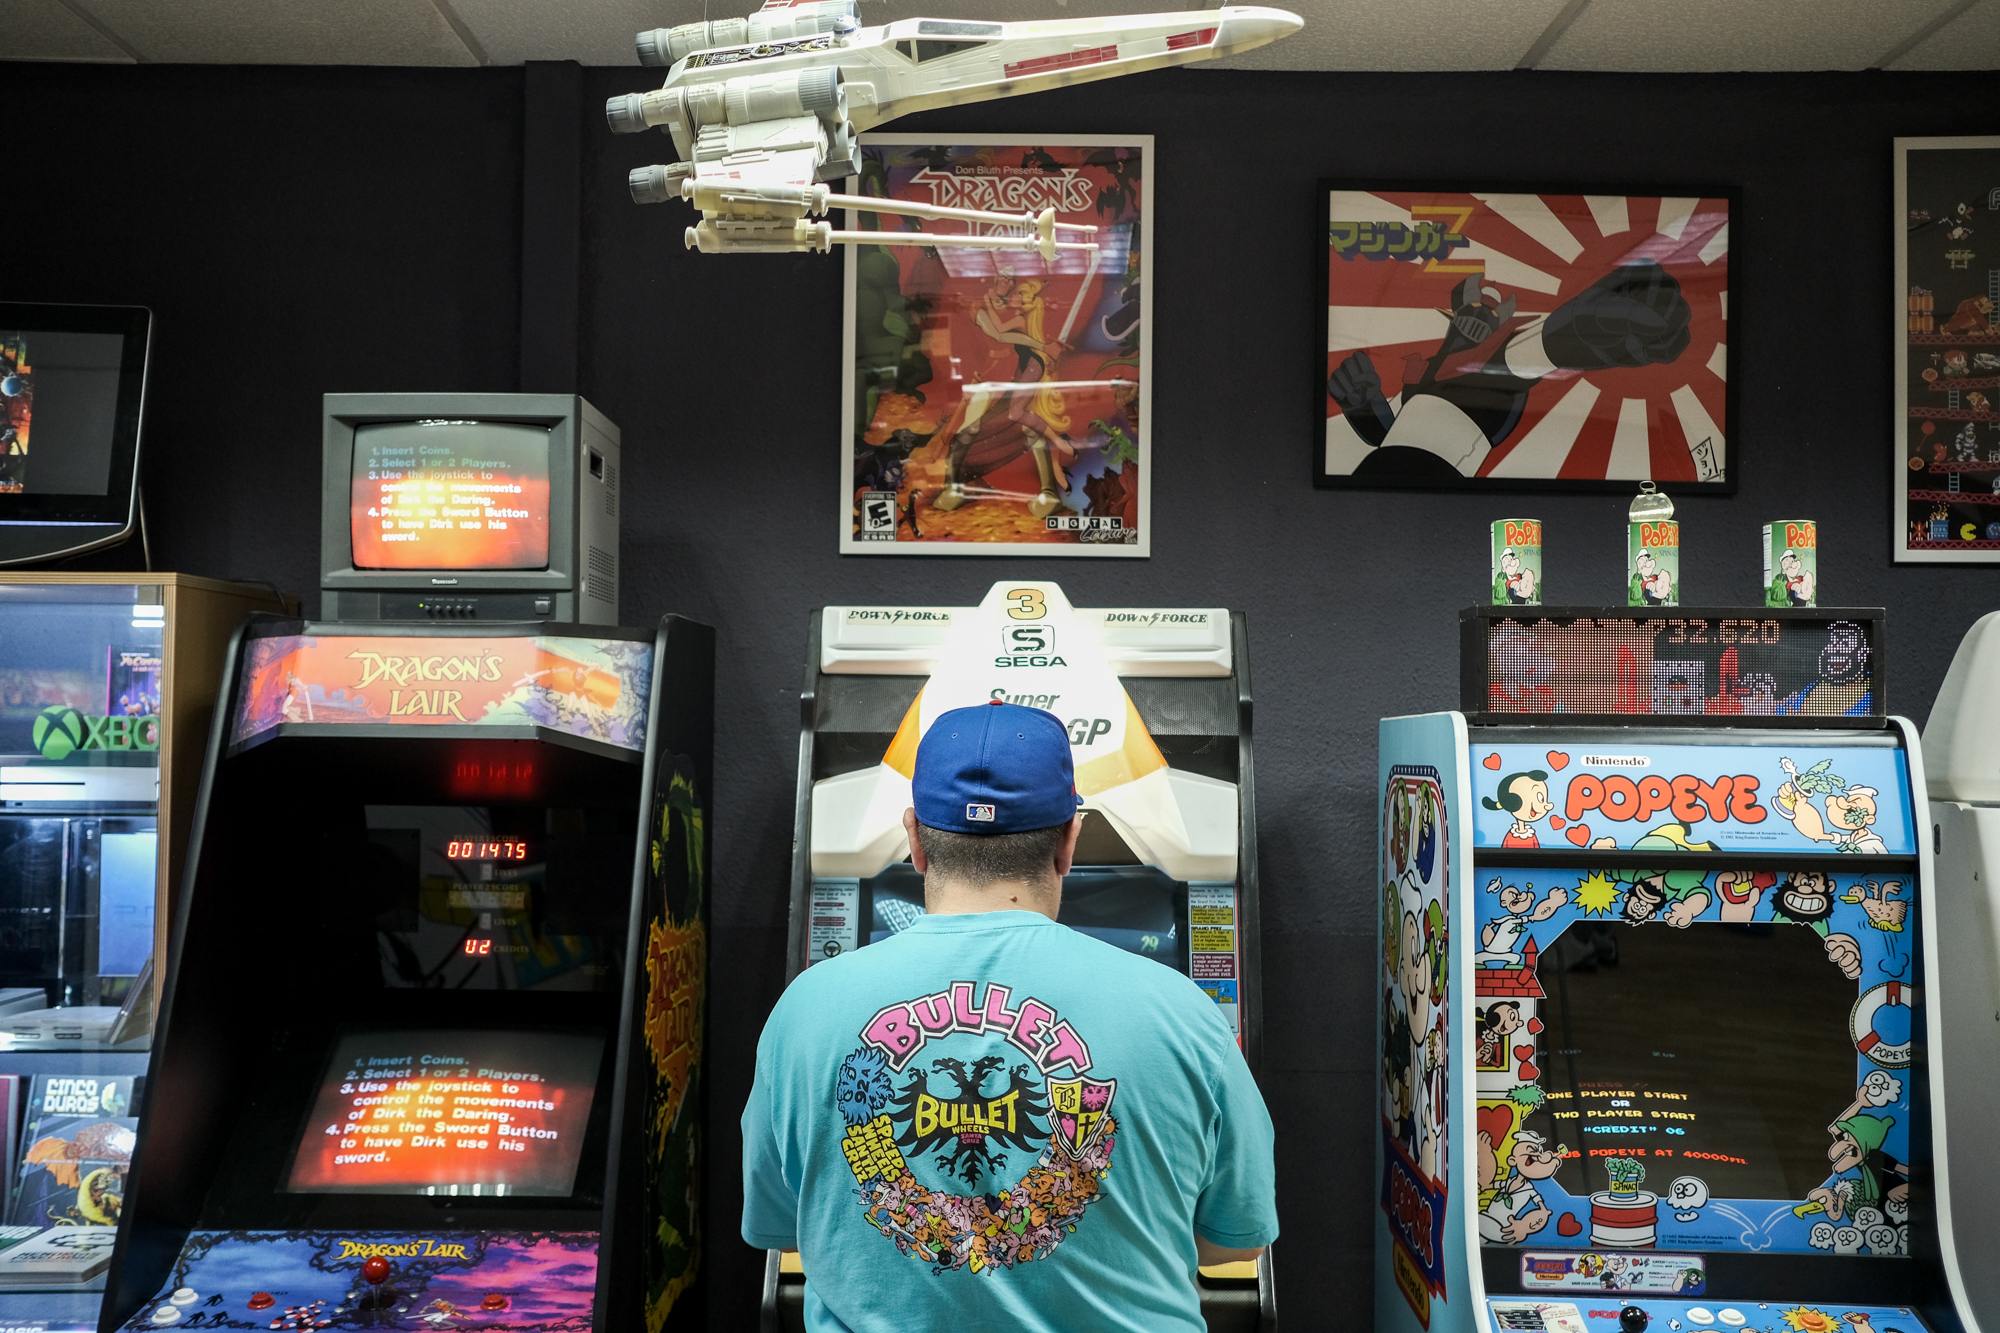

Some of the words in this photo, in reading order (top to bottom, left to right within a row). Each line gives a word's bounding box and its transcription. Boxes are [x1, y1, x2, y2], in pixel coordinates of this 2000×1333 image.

[955, 166, 974, 175] Don
[976, 166, 1000, 175] Bluth
[1003, 166, 1043, 175] Presents
[382, 447, 414, 455] Insert
[382, 458, 415, 468] Select
[448, 459, 456, 467] 2
[462, 458, 511, 469] Players.
[369, 471, 379, 480] 3.
[381, 471, 402, 480] Use
[407, 471, 425, 480] the
[430, 471, 474, 482] joystick
[481, 472, 493, 480] to
[381, 496, 393, 505] of
[368, 508, 379, 517] 4.
[485, 508, 529, 519] Button
[381, 520, 394, 529] to
[460, 521, 482, 530] use
[488, 520, 508, 530] his
[1047, 517, 1121, 529] DIGITAL
[1006, 588, 1047, 620] 3
[1105, 612, 1150, 623] DOWN
[1160, 613, 1208, 624] FORCE
[347, 649, 503, 689] DRAGON'S
[994, 656, 1067, 668] SEGA
[388, 689, 469, 722] LAIR
[1068, 718, 1112, 746] GP
[1586, 756, 1646, 766] Nintendo
[1565, 773, 1767, 824] POPEYE
[448, 842, 526, 859] 001475
[858, 981, 1093, 1077] BULLET
[355, 1058, 365, 1067] 1.
[368, 1056, 413, 1066] Insert
[421, 1054, 469, 1066] Coins.
[345, 1070, 359, 1081] 2.
[363, 1068, 411, 1079] Select
[419, 1069, 427, 1077] 1
[433, 1069, 451, 1078] or
[458, 1068, 469, 1078] 2
[477, 1068, 546, 1082] Players.
[46, 1079, 98, 1096] CINCO
[340, 1083, 354, 1094] 3.
[358, 1081, 389, 1093] Use
[395, 1080, 421, 1092] the
[427, 1081, 492, 1094] joystick
[501, 1083, 519, 1094] to
[353, 1095, 410, 1107] control
[417, 1094, 444, 1105] the
[454, 1095, 555, 1111] movements
[1546, 1091, 1573, 1100] ONE
[1581, 1090, 1636, 1098] PLAYER
[1644, 1091, 1688, 1101] START
[43, 1095, 99, 1113] DUROS
[348, 1108, 365, 1120] of
[373, 1107, 406, 1119] Dirk
[416, 1107, 443, 1118] the
[452, 1107, 515, 1122] Daring.
[915, 1089, 1020, 1138] BULLET
[1553, 1111, 1579, 1120] TWO
[1587, 1110, 1643, 1118] PLAYER
[1651, 1111, 1697, 1121] START
[325, 1124, 340, 1136] 4.
[343, 1122, 389, 1134] Press
[398, 1122, 426, 1133] the
[433, 1122, 490, 1135] Sword
[497, 1124, 558, 1140] Button
[951, 1125, 990, 1134] WHEELS
[1665, 1127, 1686, 1136] 06
[340, 1138, 357, 1149] to
[364, 1136, 404, 1147] have
[410, 1135, 446, 1148] Dirk
[456, 1137, 489, 1149] use
[498, 1139, 525, 1152] his
[873, 1114, 905, 1169] SPEED
[334, 1152, 391, 1165] sword.
[847, 1124, 880, 1179] SANTA
[862, 1122, 901, 1182] WHEELS
[1589, 1149, 1647, 1157] POPEYE
[1654, 1149, 1674, 1157] AT
[842, 1137, 868, 1185] CRUZ
[335, 1240, 418, 1259] DRAGON'S
[421, 1240, 471, 1259] LAIR
